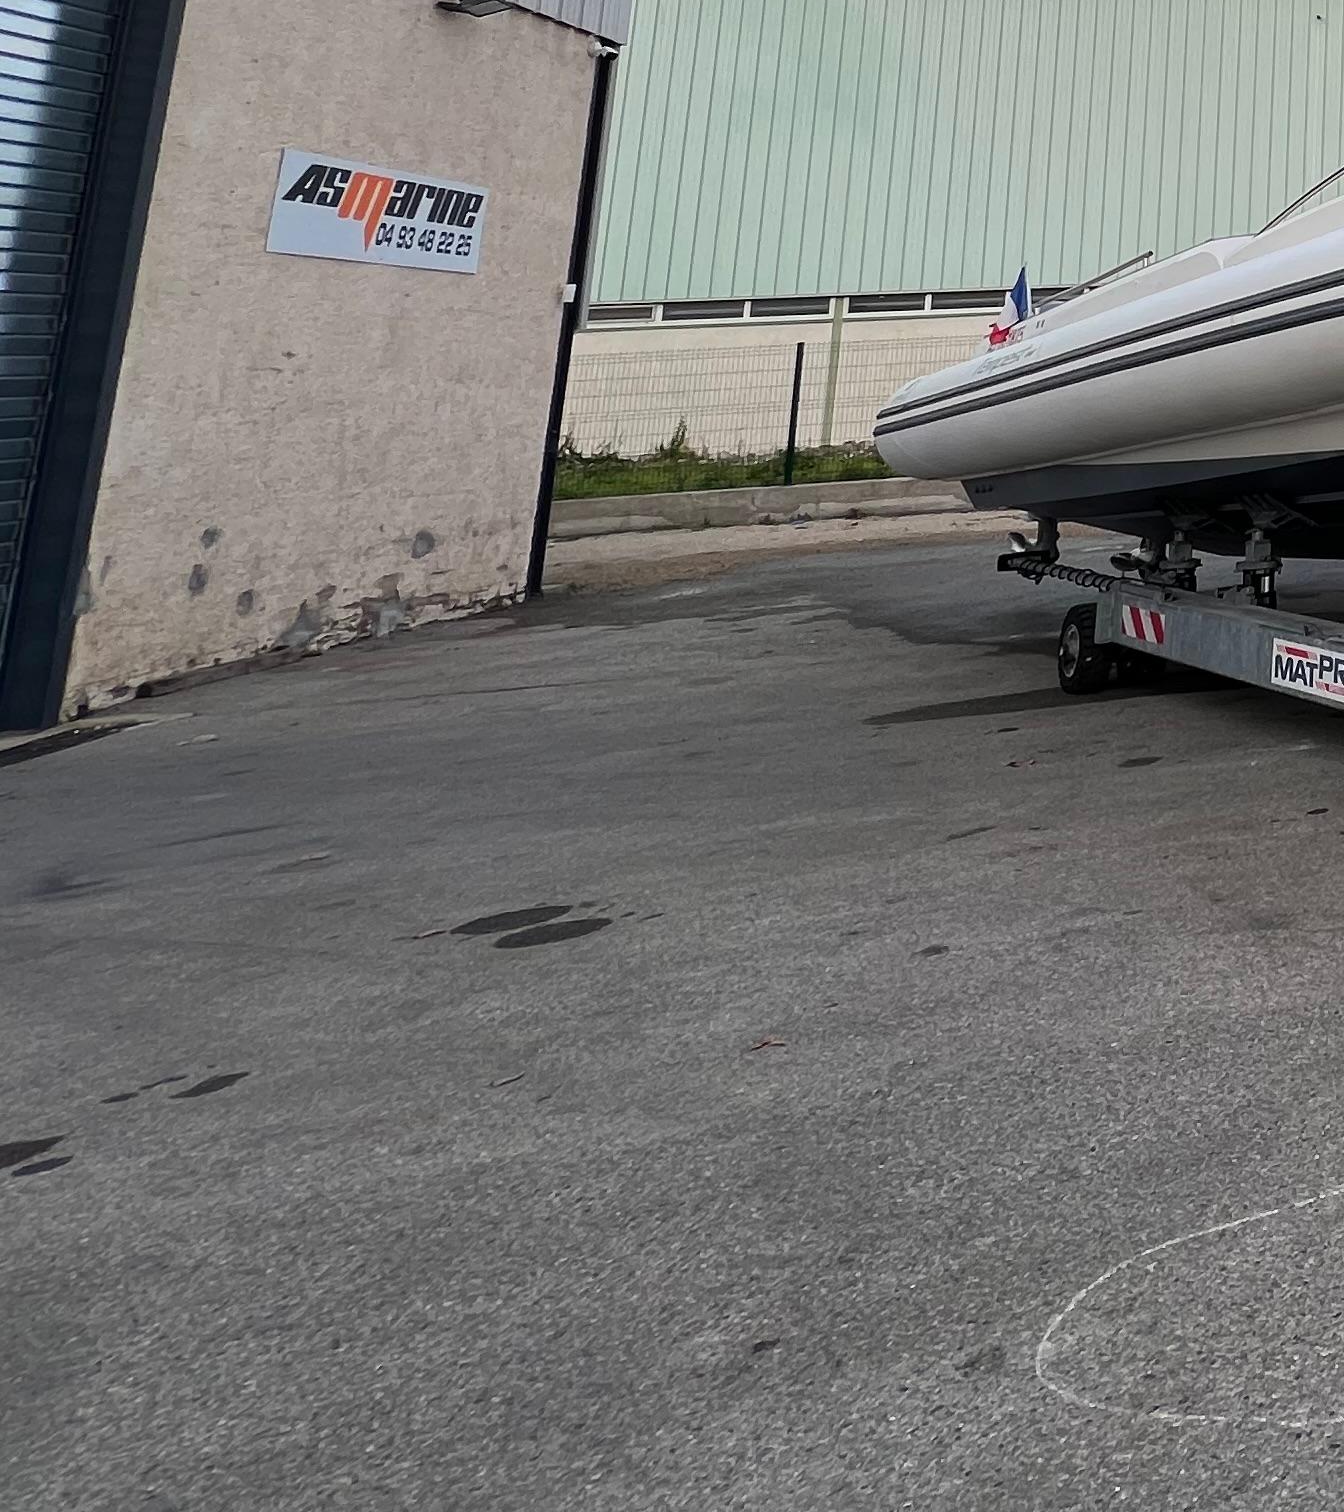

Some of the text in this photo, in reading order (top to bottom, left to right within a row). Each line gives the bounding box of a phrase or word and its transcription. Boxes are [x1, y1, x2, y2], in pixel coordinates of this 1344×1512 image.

[375, 222, 473, 256] 04 93 48 22 25
